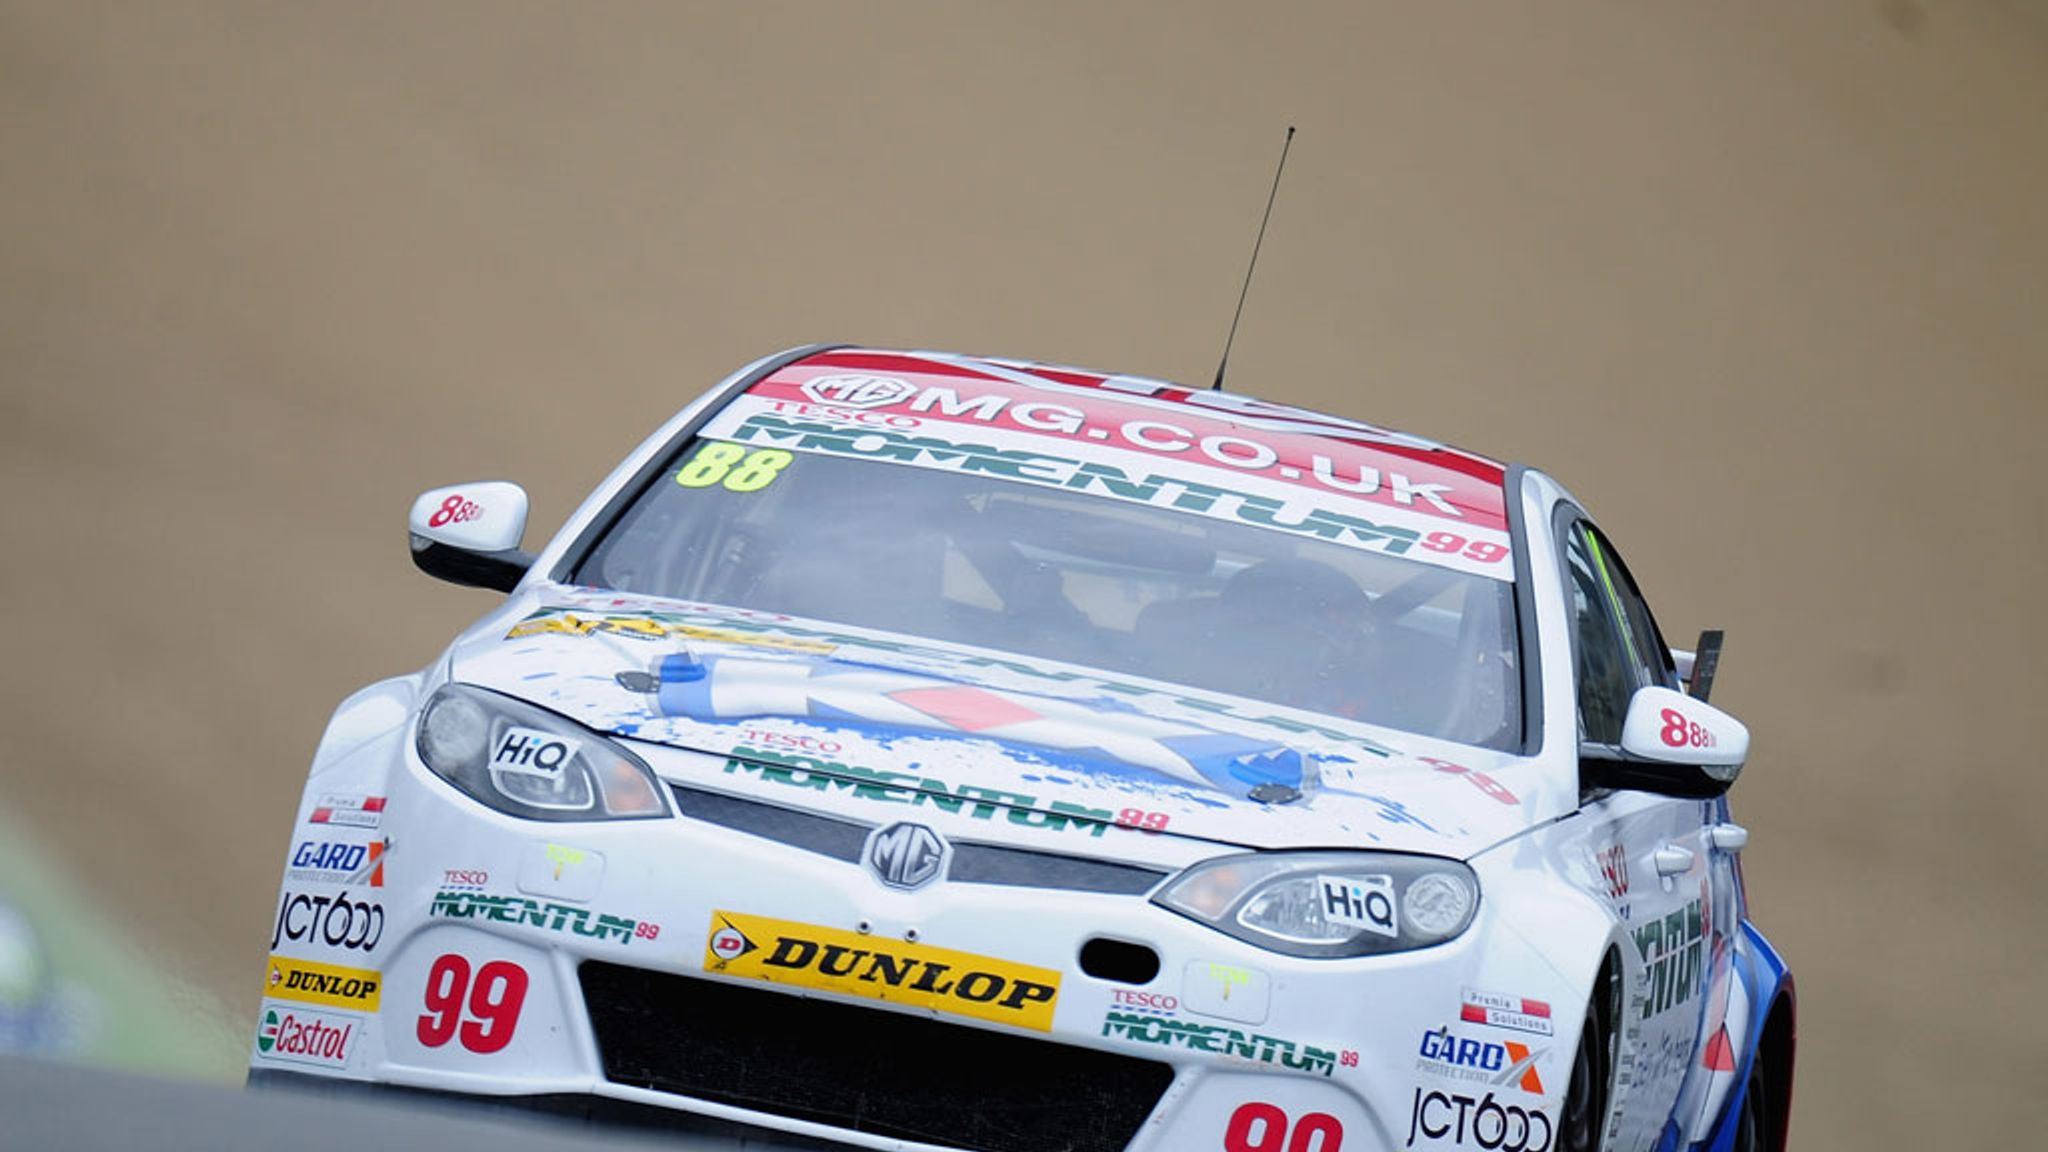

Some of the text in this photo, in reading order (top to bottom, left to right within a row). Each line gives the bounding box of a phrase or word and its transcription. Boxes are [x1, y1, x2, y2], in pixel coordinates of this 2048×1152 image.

[763, 400, 921, 429] TESCO
[676, 441, 793, 492] 88
[910, 386, 1465, 517] MG.CO.UK
[732, 414, 1510, 563] MOMENTUM 99
[495, 735, 569, 773] HiQ
[743, 729, 843, 754] TESCO
[722, 744, 1171, 838] MOMENTUM 99
[443, 870, 489, 887] TESCO
[873, 825, 944, 884] MG
[271, 891, 385, 953] JCT600
[430, 891, 661, 945] MOMENTUM 99
[1323, 879, 1395, 929] HiQ
[284, 969, 378, 1001] DUNLOP
[762, 936, 1057, 1011] DUNLOP
[1111, 988, 1178, 1011] TESCO
[416, 953, 530, 1055] 99
[1491, 1012, 1548, 1031] Solutions
[275, 1013, 352, 1061] Castrol
[1101, 1011, 1360, 1077] MOMENTUM 99
[1406, 1086, 1553, 1152] JCT600
